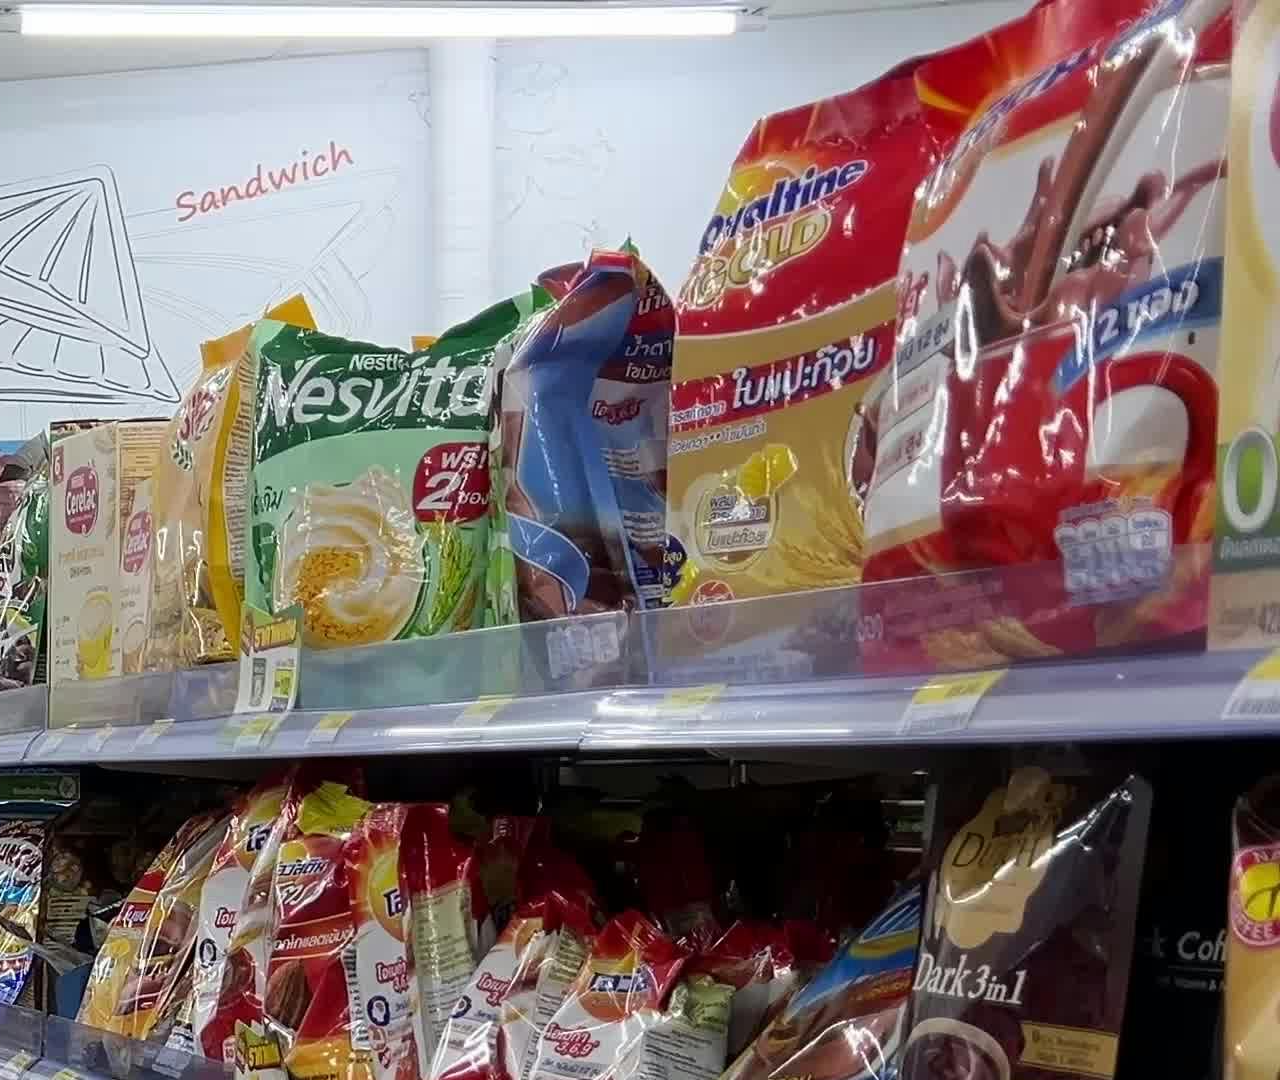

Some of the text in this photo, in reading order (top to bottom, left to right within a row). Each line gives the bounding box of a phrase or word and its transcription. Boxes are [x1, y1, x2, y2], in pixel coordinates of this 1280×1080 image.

[175, 141, 355, 222] Sandwich
[65, 487, 98, 516] Cerelac
[416, 471, 461, 511] 2
[914, 952, 971, 999] Dark
